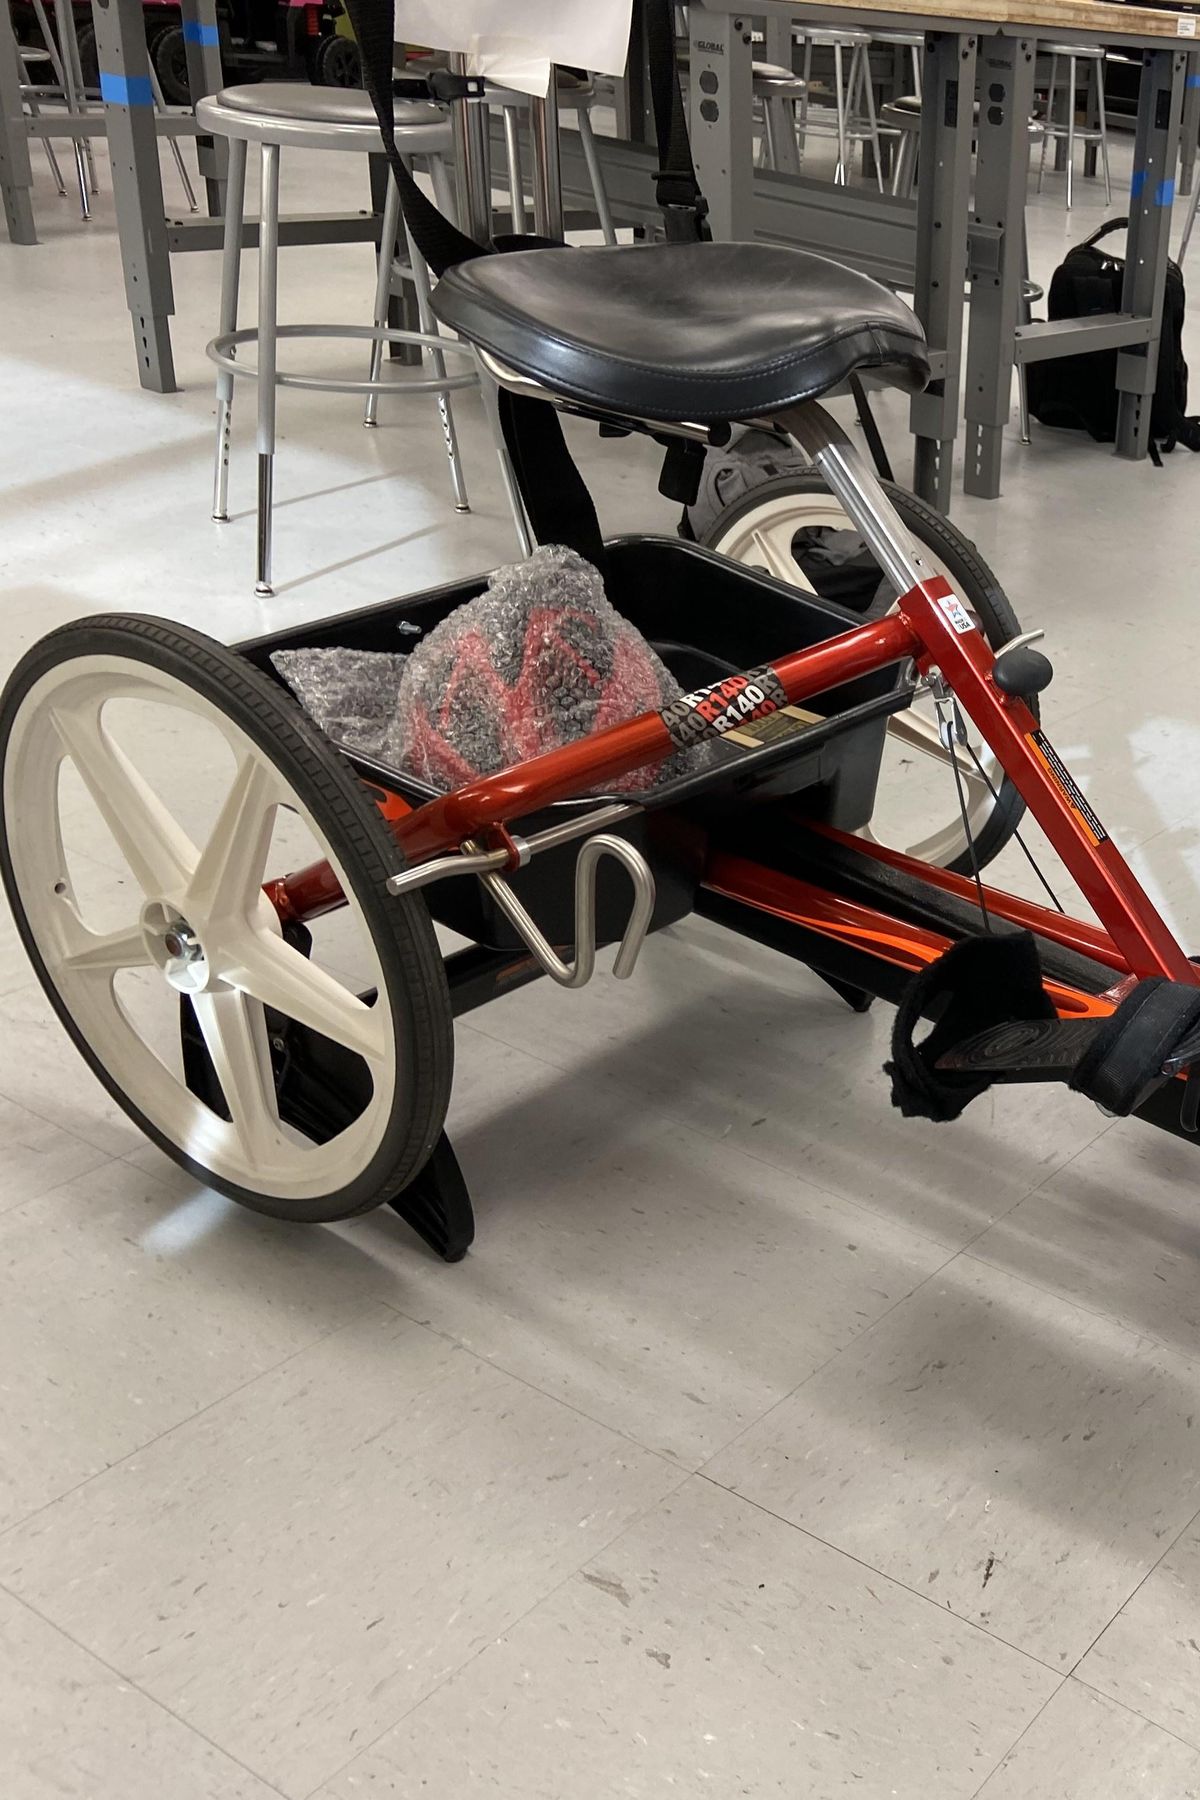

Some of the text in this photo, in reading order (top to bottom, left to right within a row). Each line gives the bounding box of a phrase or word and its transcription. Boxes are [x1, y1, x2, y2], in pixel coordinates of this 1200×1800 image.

[960, 621, 971, 630] USA
[695, 676, 749, 722] R140
[712, 684, 765, 733] R140
[1047, 767, 1072, 804] WARNING
